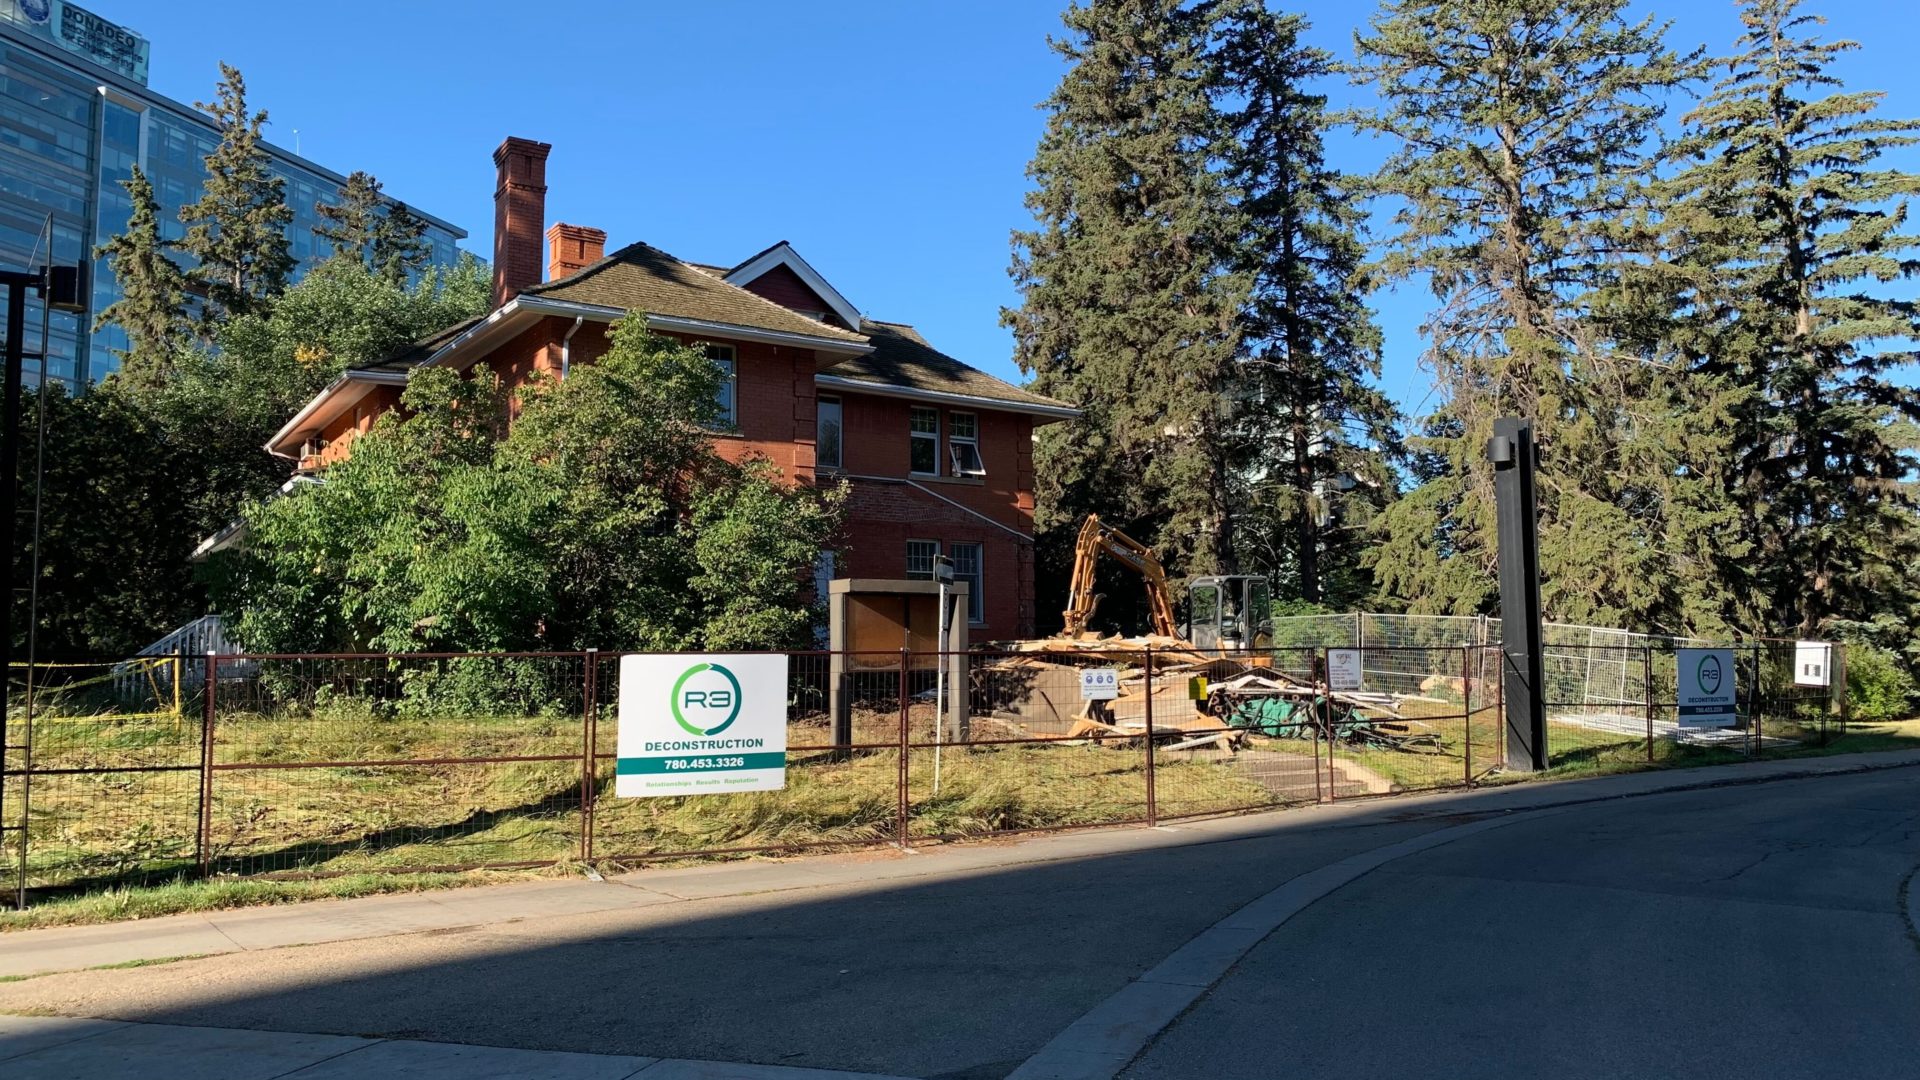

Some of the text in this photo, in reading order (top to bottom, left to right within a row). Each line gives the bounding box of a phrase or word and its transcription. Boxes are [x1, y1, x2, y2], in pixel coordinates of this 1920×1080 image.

[62, 5, 136, 48] DONADEO
[1702, 668, 1719, 680] R3
[684, 690, 731, 709] R3
[644, 738, 764, 752] DECONSTRUCTION
[664, 757, 744, 770] 780.453.3326
[645, 780, 692, 788] Relationships
[724, 777, 759, 785] Reputation
